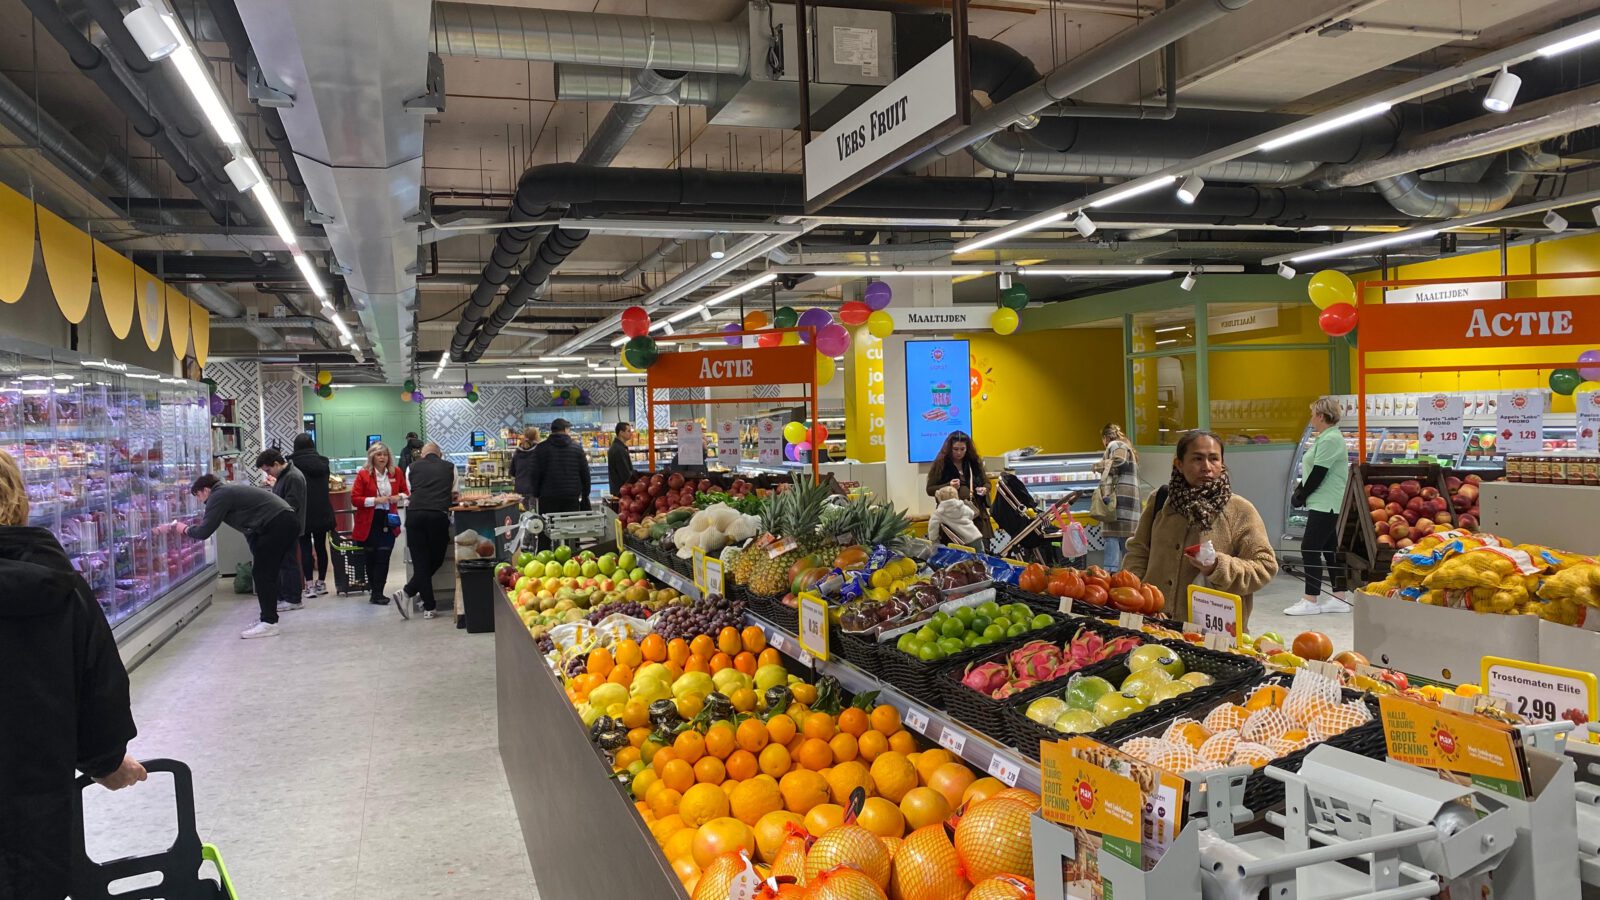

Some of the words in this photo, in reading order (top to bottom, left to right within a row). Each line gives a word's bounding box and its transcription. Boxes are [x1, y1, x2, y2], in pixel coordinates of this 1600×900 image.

[1492, 671, 1554, 690] Trostomaten
[1557, 683, 1581, 695] Elite
[1390, 730, 1417, 743] GROTE
[1392, 743, 1429, 756] OPENING
